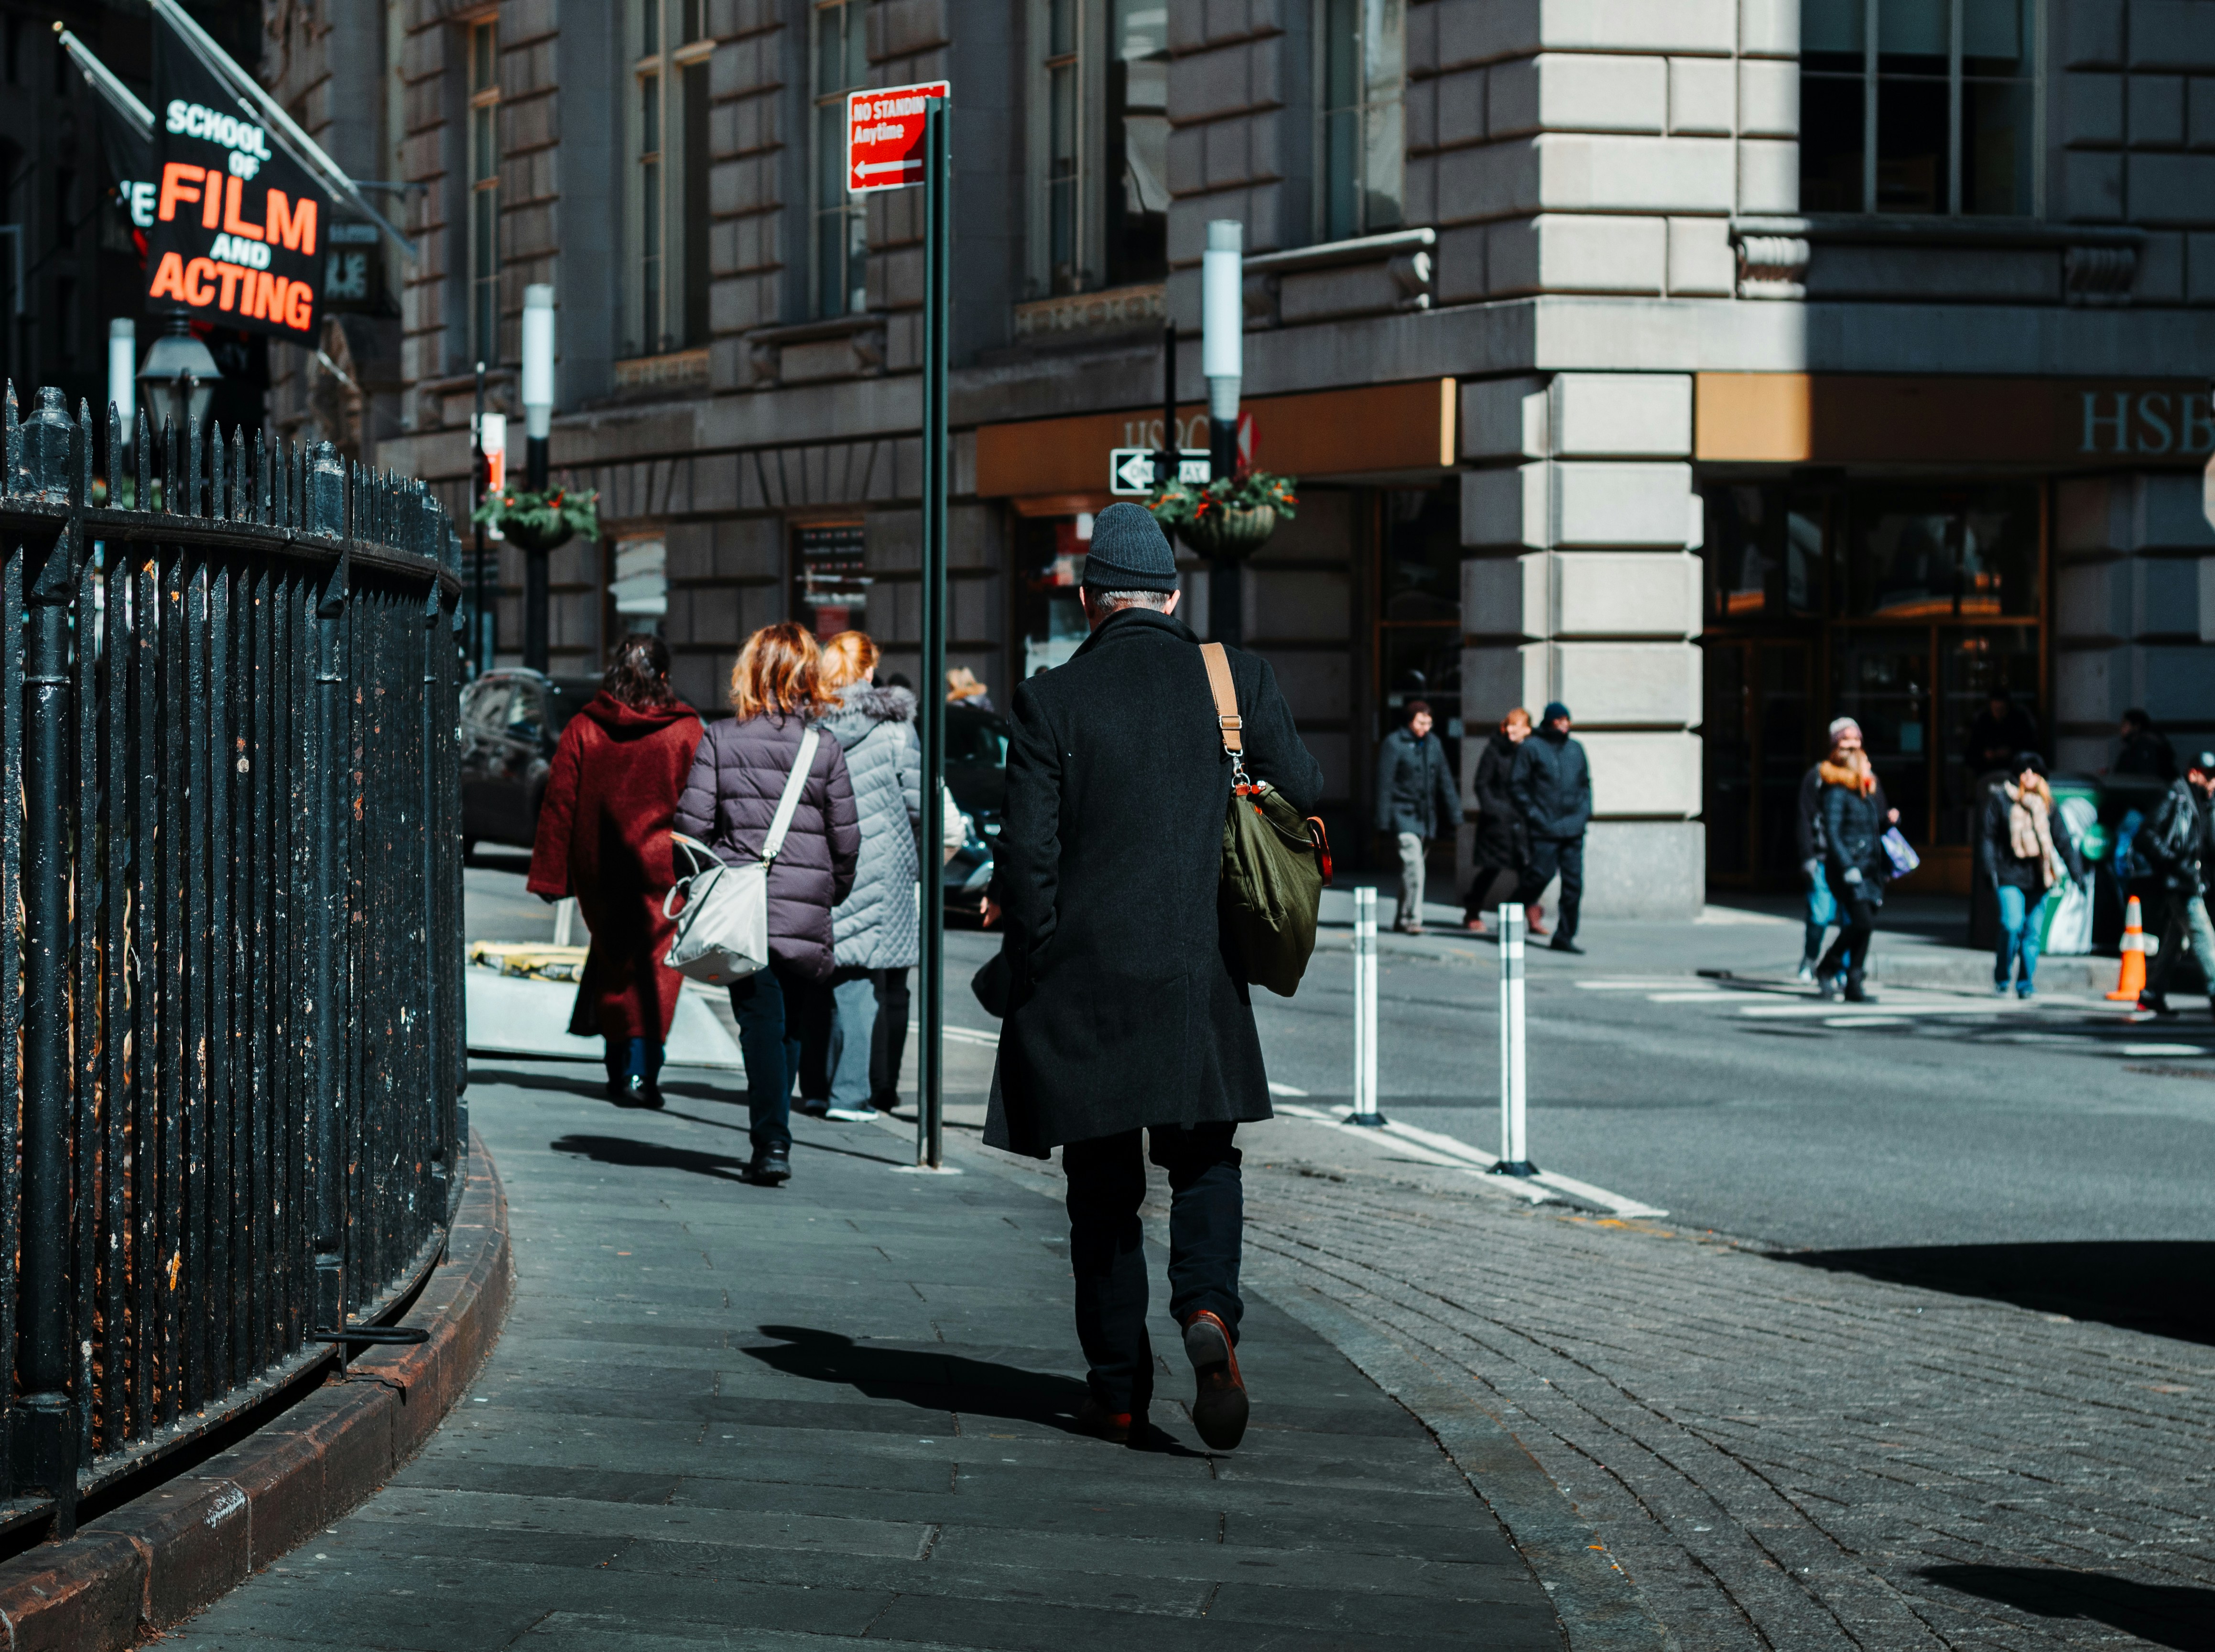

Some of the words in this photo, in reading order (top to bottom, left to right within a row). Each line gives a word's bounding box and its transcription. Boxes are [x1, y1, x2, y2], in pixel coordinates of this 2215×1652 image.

[854, 103, 872, 121] NO
[873, 96, 925, 120] STANDIN
[166, 99, 271, 161] SCHOOL
[854, 122, 904, 145] Anytime
[228, 151, 260, 180] OF
[159, 162, 317, 256] FILM
[209, 233, 271, 270] AND
[149, 251, 314, 332] ACTING
